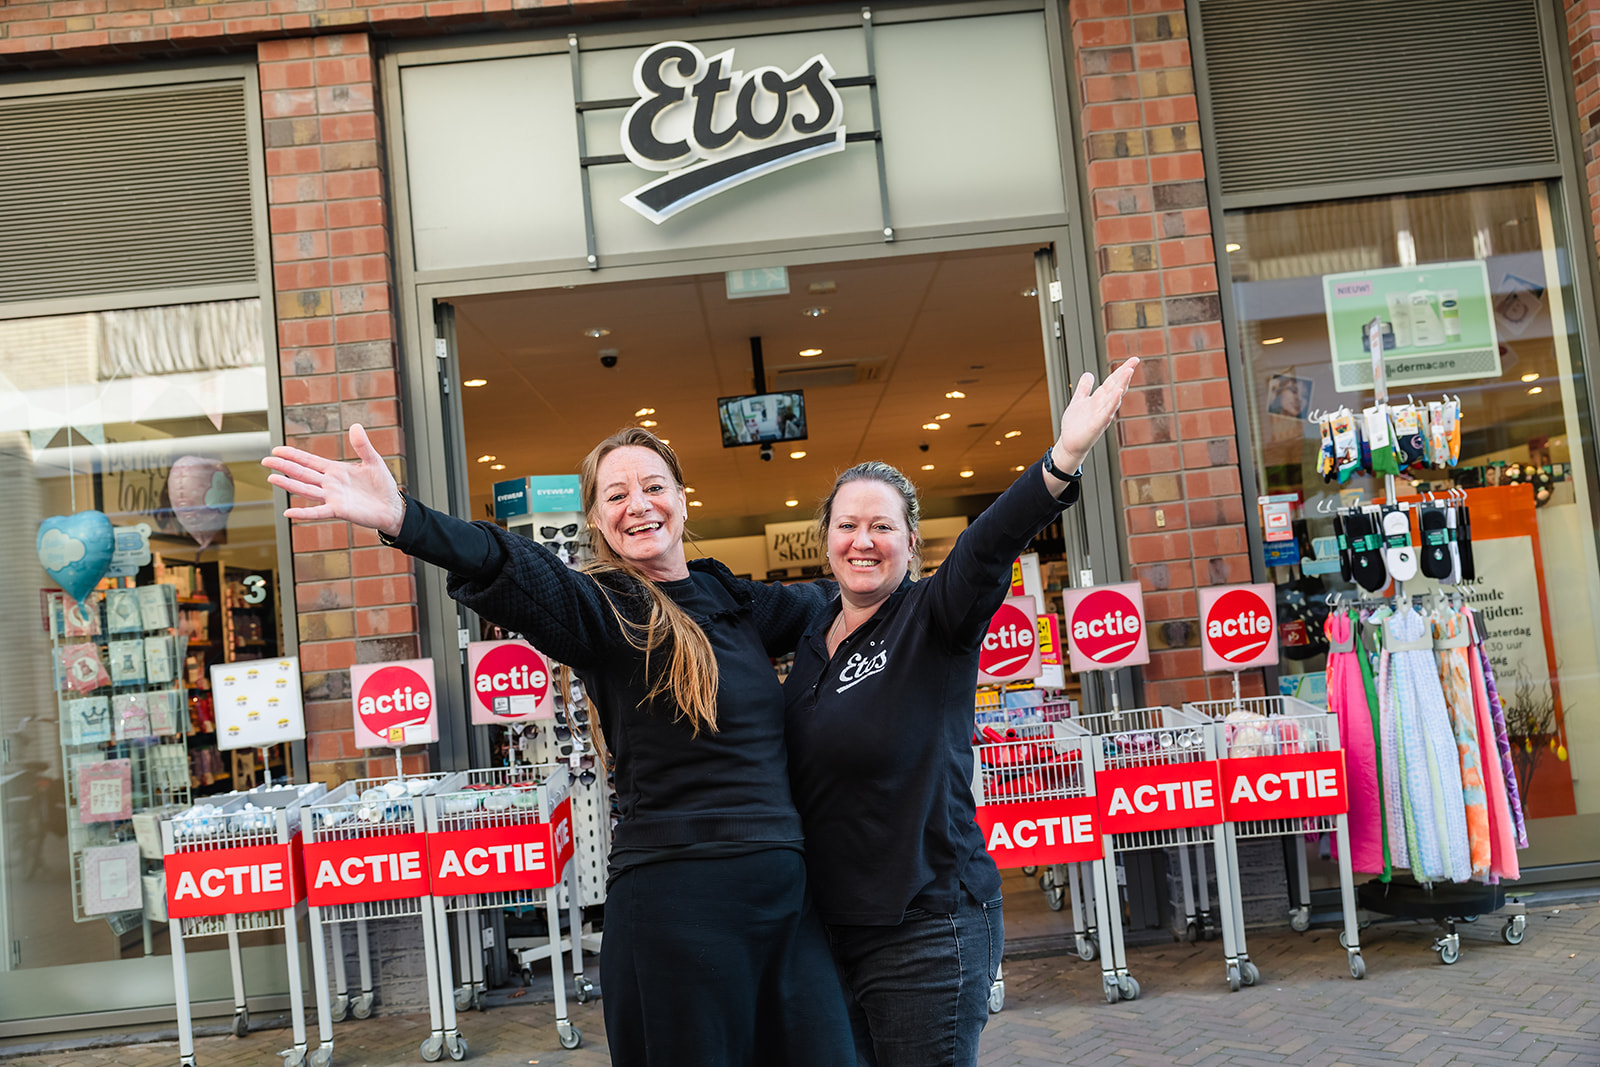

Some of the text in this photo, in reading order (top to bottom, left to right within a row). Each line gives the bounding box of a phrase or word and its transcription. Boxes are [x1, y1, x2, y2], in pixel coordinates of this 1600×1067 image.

[628, 46, 835, 162] Etos
[1397, 359, 1456, 373] dermacare
[497, 491, 524, 502] EYEWEAR
[773, 525, 818, 550] perfe
[778, 544, 819, 561] skin
[242, 574, 267, 604] 3
[981, 623, 1034, 651] ctie
[1073, 608, 1140, 639] actie
[1208, 610, 1271, 639] actie
[476, 664, 547, 693] actie
[839, 649, 887, 682] Etos
[359, 686, 432, 716] actie
[1108, 779, 1214, 816] ACTIE
[1230, 768, 1338, 803] ACTIE
[987, 814, 1094, 851] ACTIE
[314, 851, 422, 889] ACTIE
[438, 841, 546, 878] ACTIE
[174, 861, 283, 901] ACTIE
